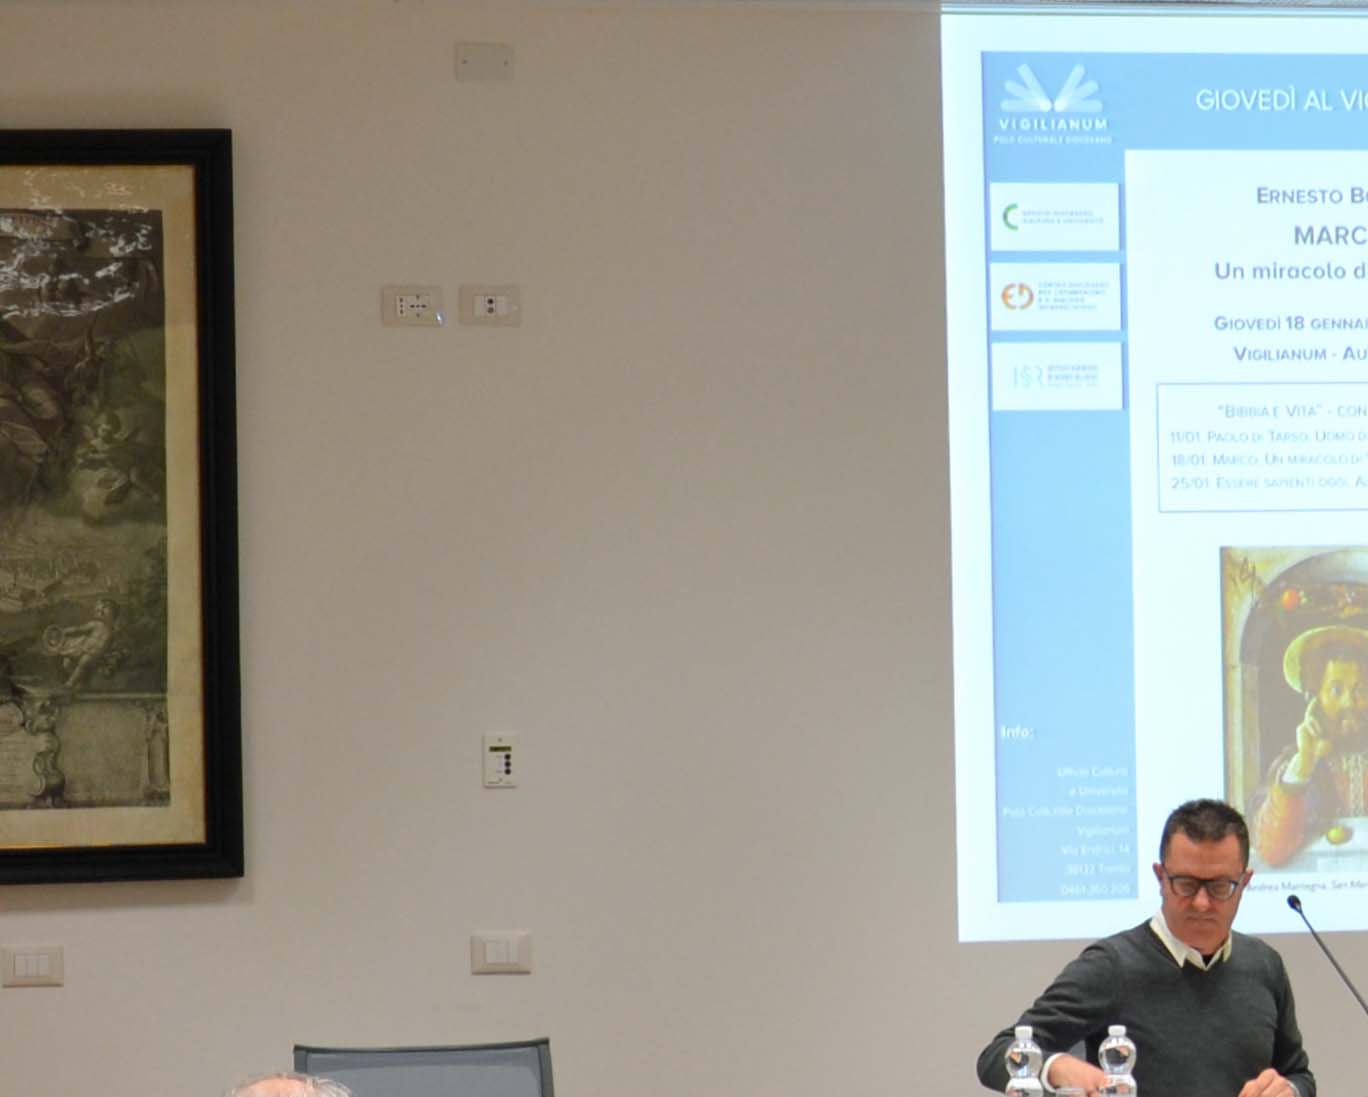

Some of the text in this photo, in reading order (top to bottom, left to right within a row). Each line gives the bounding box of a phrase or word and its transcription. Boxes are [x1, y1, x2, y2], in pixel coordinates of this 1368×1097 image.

[1196, 84, 1295, 113] GIOVEDÌ
[1305, 88, 1333, 113] AL
[998, 117, 1109, 131] VIGILIANUM
[1214, 261, 1245, 282] Un
[1251, 259, 1347, 282] miracolo
[1285, 313, 1306, 332] 18
[1170, 431, 1200, 444] 11/01
[1172, 454, 1205, 467] 18/01
[1172, 478, 1209, 491] 25/01
[1000, 725, 1035, 739] Info:
